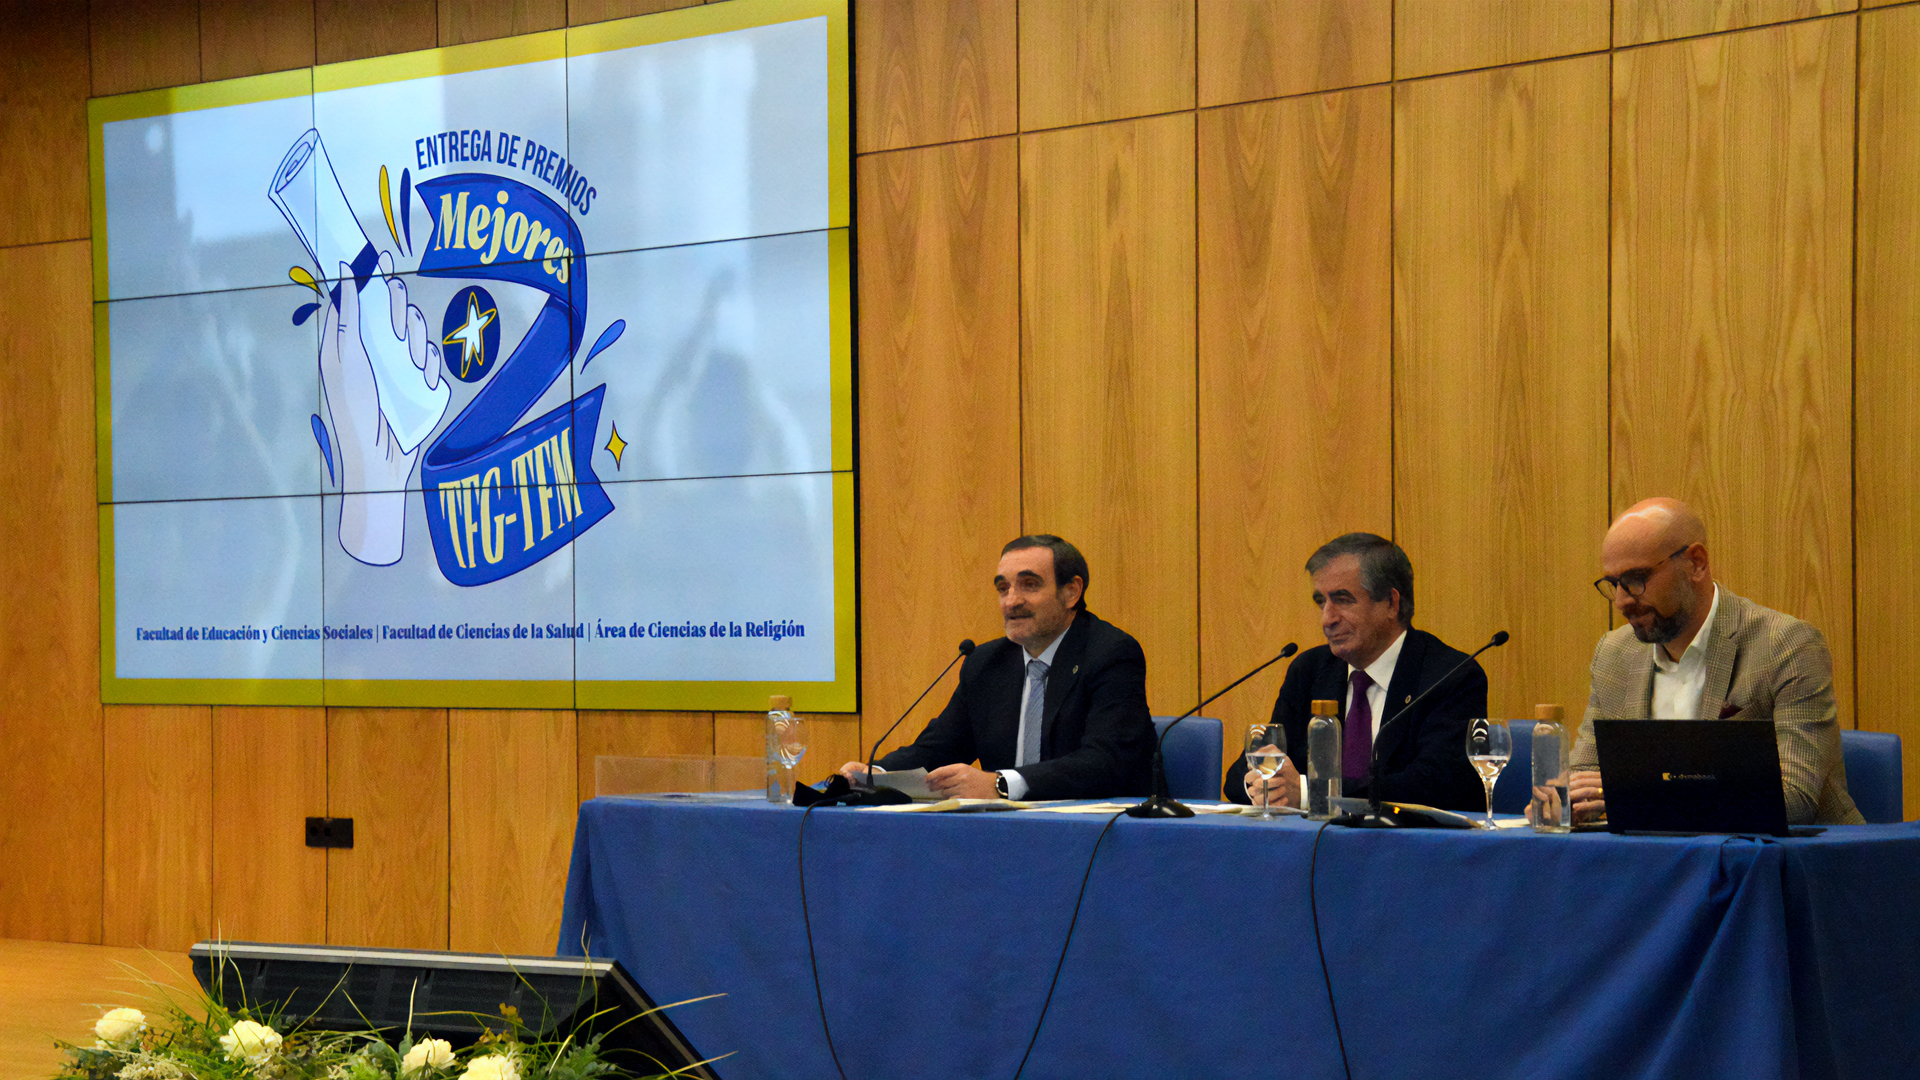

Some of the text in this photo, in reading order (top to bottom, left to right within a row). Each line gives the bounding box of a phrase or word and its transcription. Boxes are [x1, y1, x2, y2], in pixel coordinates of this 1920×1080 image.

[415, 129, 597, 216] ENTREGA DE PREMIOS
[433, 190, 574, 284] Mejores
[438, 426, 584, 569] TFG-TFM
[136, 626, 184, 641] Facultad
[185, 626, 200, 641] de
[201, 625, 261, 641] Educación
[262, 628, 269, 644] y
[271, 625, 321, 641] Ciencias
[322, 624, 374, 640] Sociales
[382, 624, 436, 640] Facultad
[438, 624, 453, 640] de
[455, 623, 511, 640] Ciencias
[512, 623, 528, 639] de
[531, 623, 544, 639] la
[545, 623, 584, 639] Salud
[595, 618, 626, 639] Área
[629, 622, 646, 639] de
[648, 620, 706, 639] Ciencias
[709, 621, 726, 638] de
[729, 621, 743, 638] la
[746, 619, 805, 641] Religión
